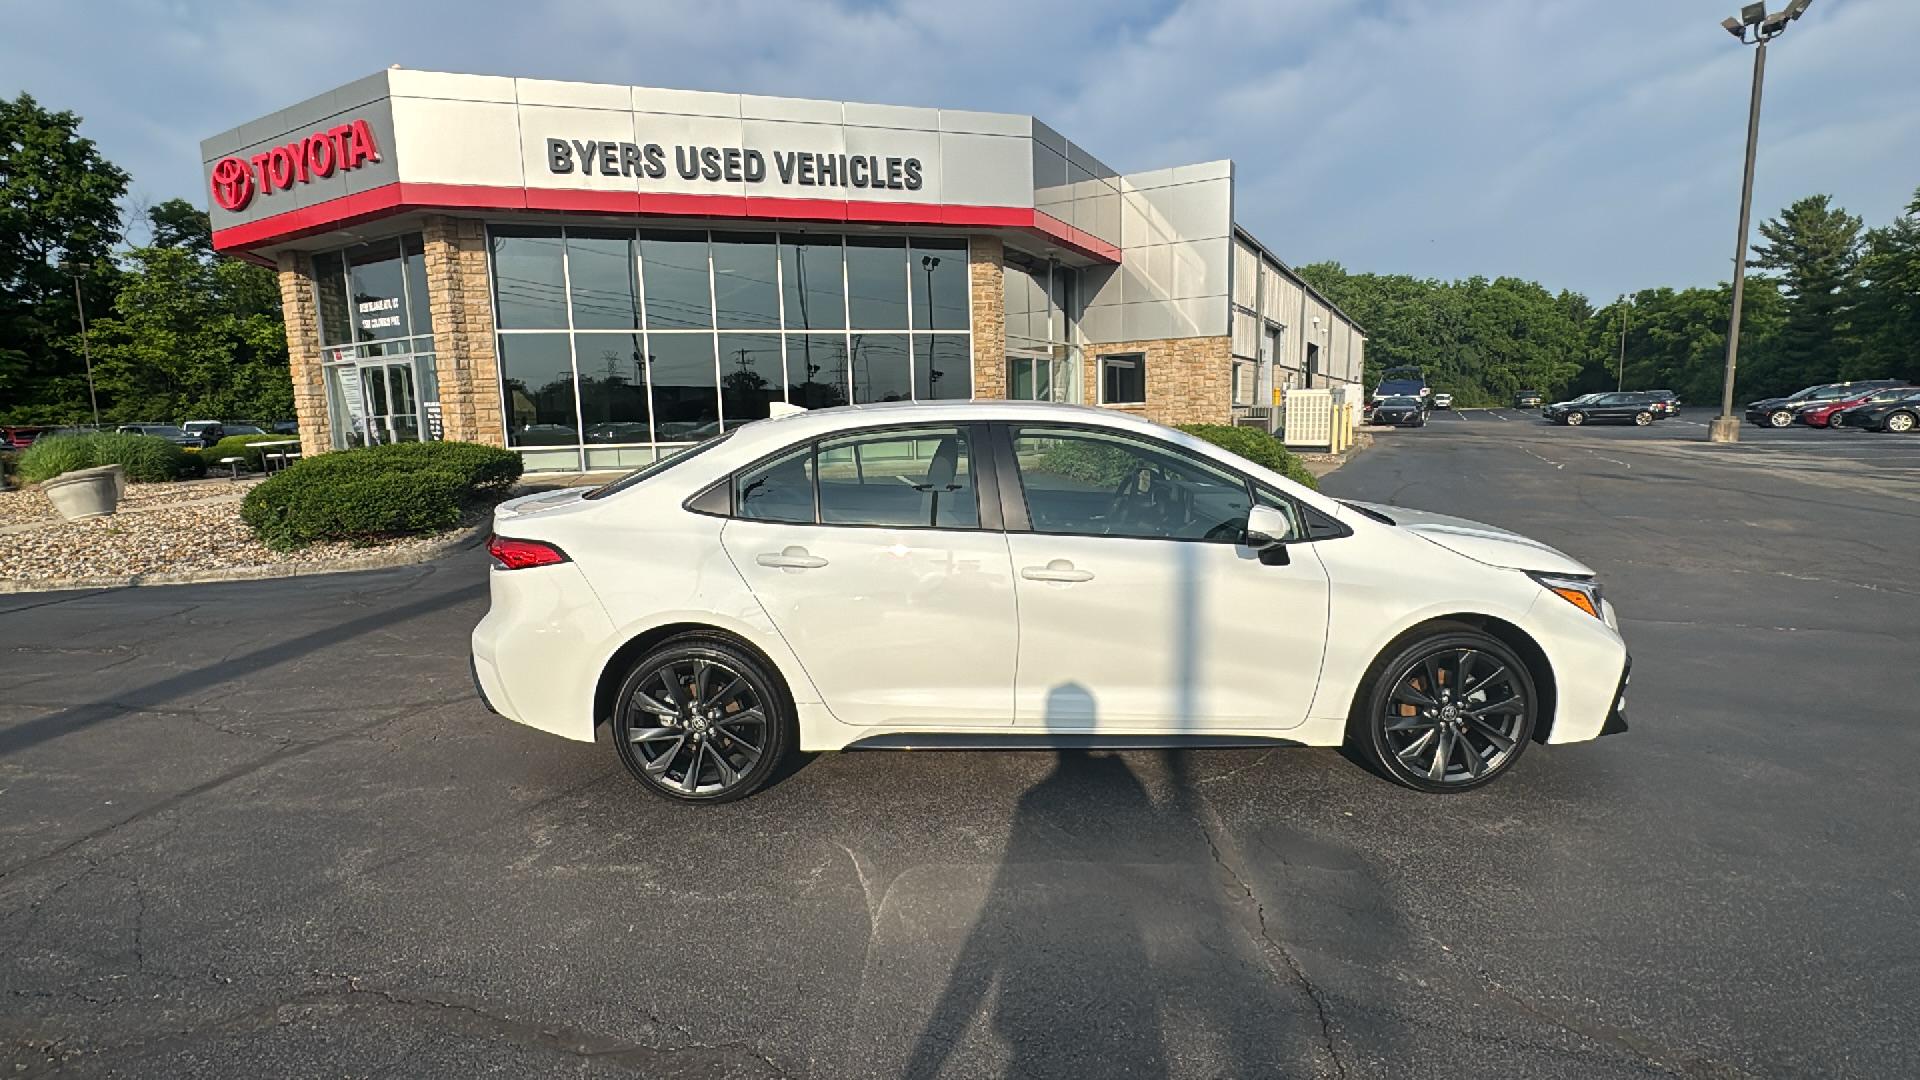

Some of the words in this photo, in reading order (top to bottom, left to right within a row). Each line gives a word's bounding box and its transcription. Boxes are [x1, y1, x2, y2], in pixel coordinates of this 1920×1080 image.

[251, 119, 380, 194] TOYOTA
[547, 138, 666, 178] BYERS
[675, 146, 765, 182] USED
[774, 151, 922, 190] VEHICLES
